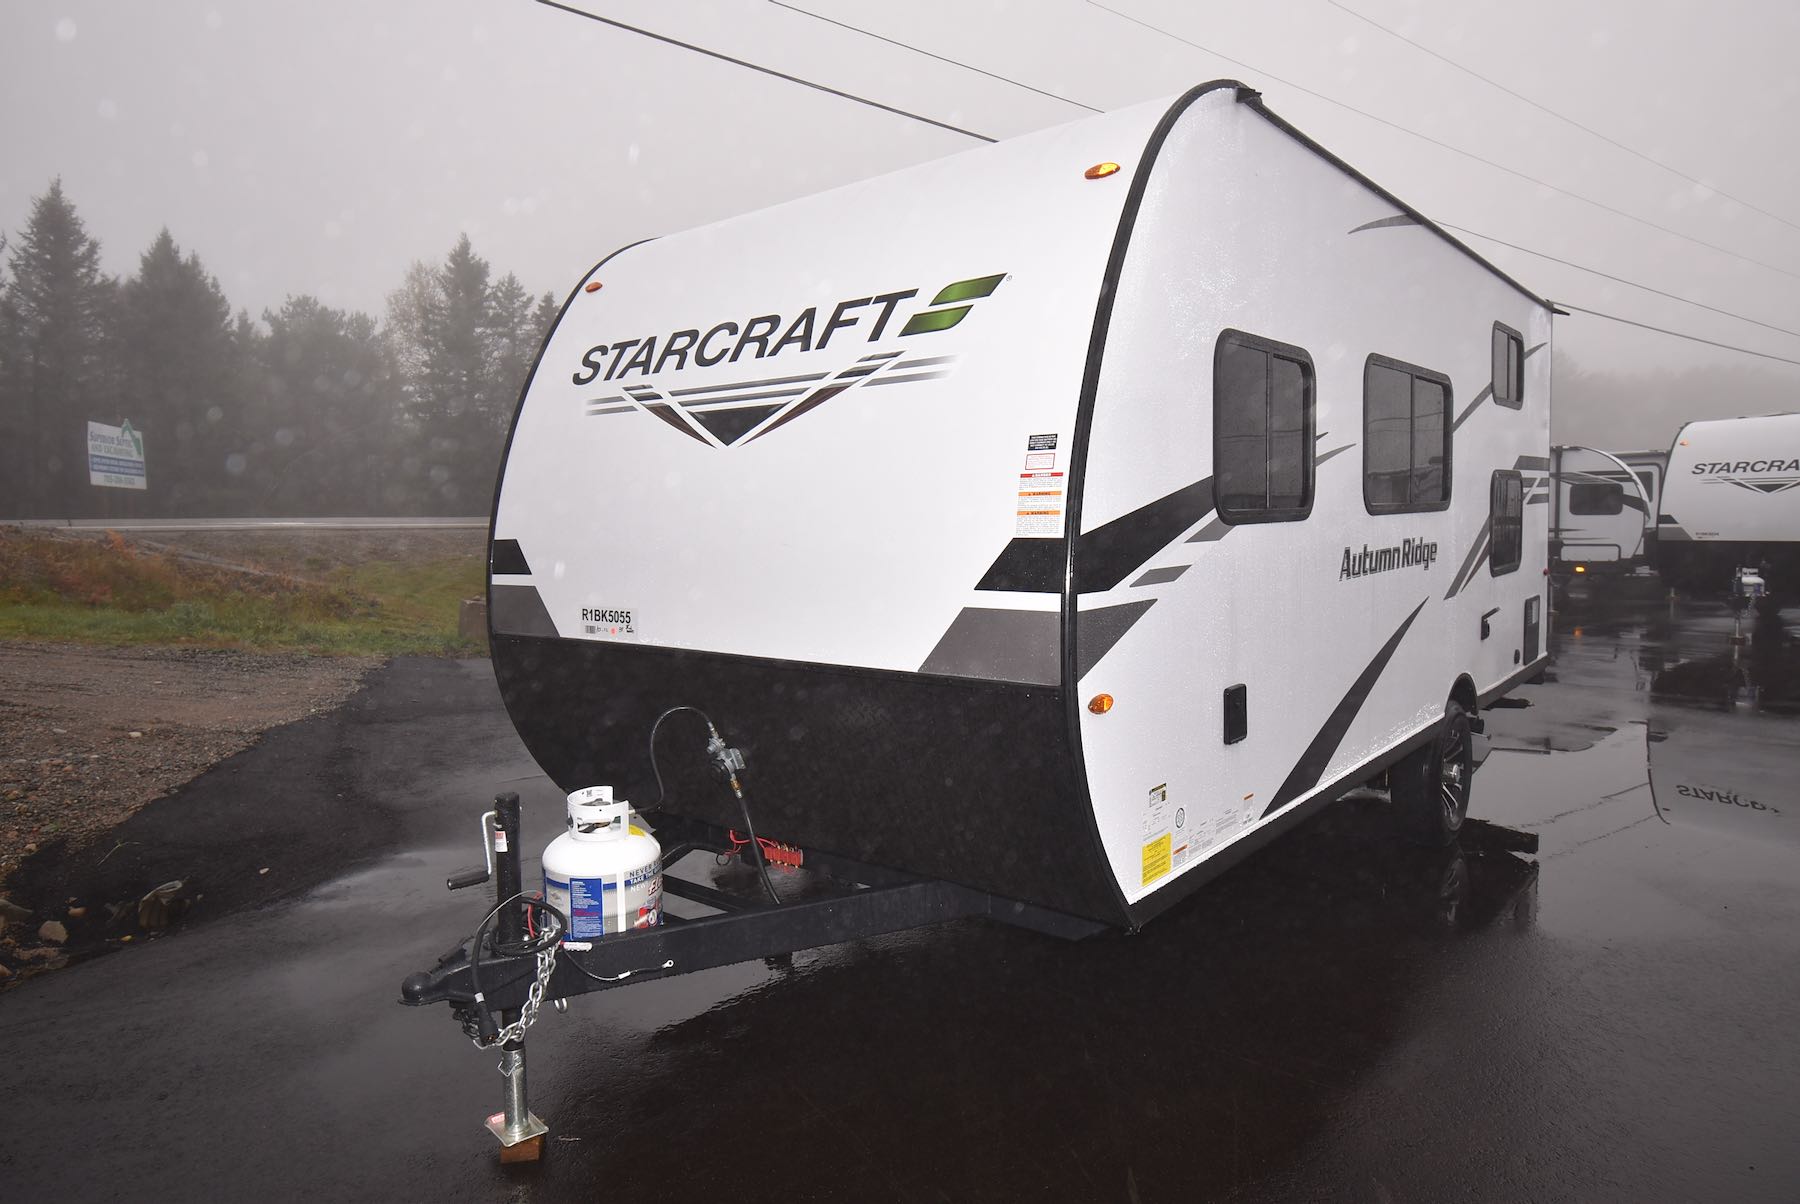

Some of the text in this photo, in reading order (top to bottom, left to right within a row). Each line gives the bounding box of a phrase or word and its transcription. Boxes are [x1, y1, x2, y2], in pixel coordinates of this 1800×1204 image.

[572, 288, 920, 386] STARCRAFT
[1691, 459, 1800, 475] STARCRA
[581, 608, 632, 624] R1BK5055
